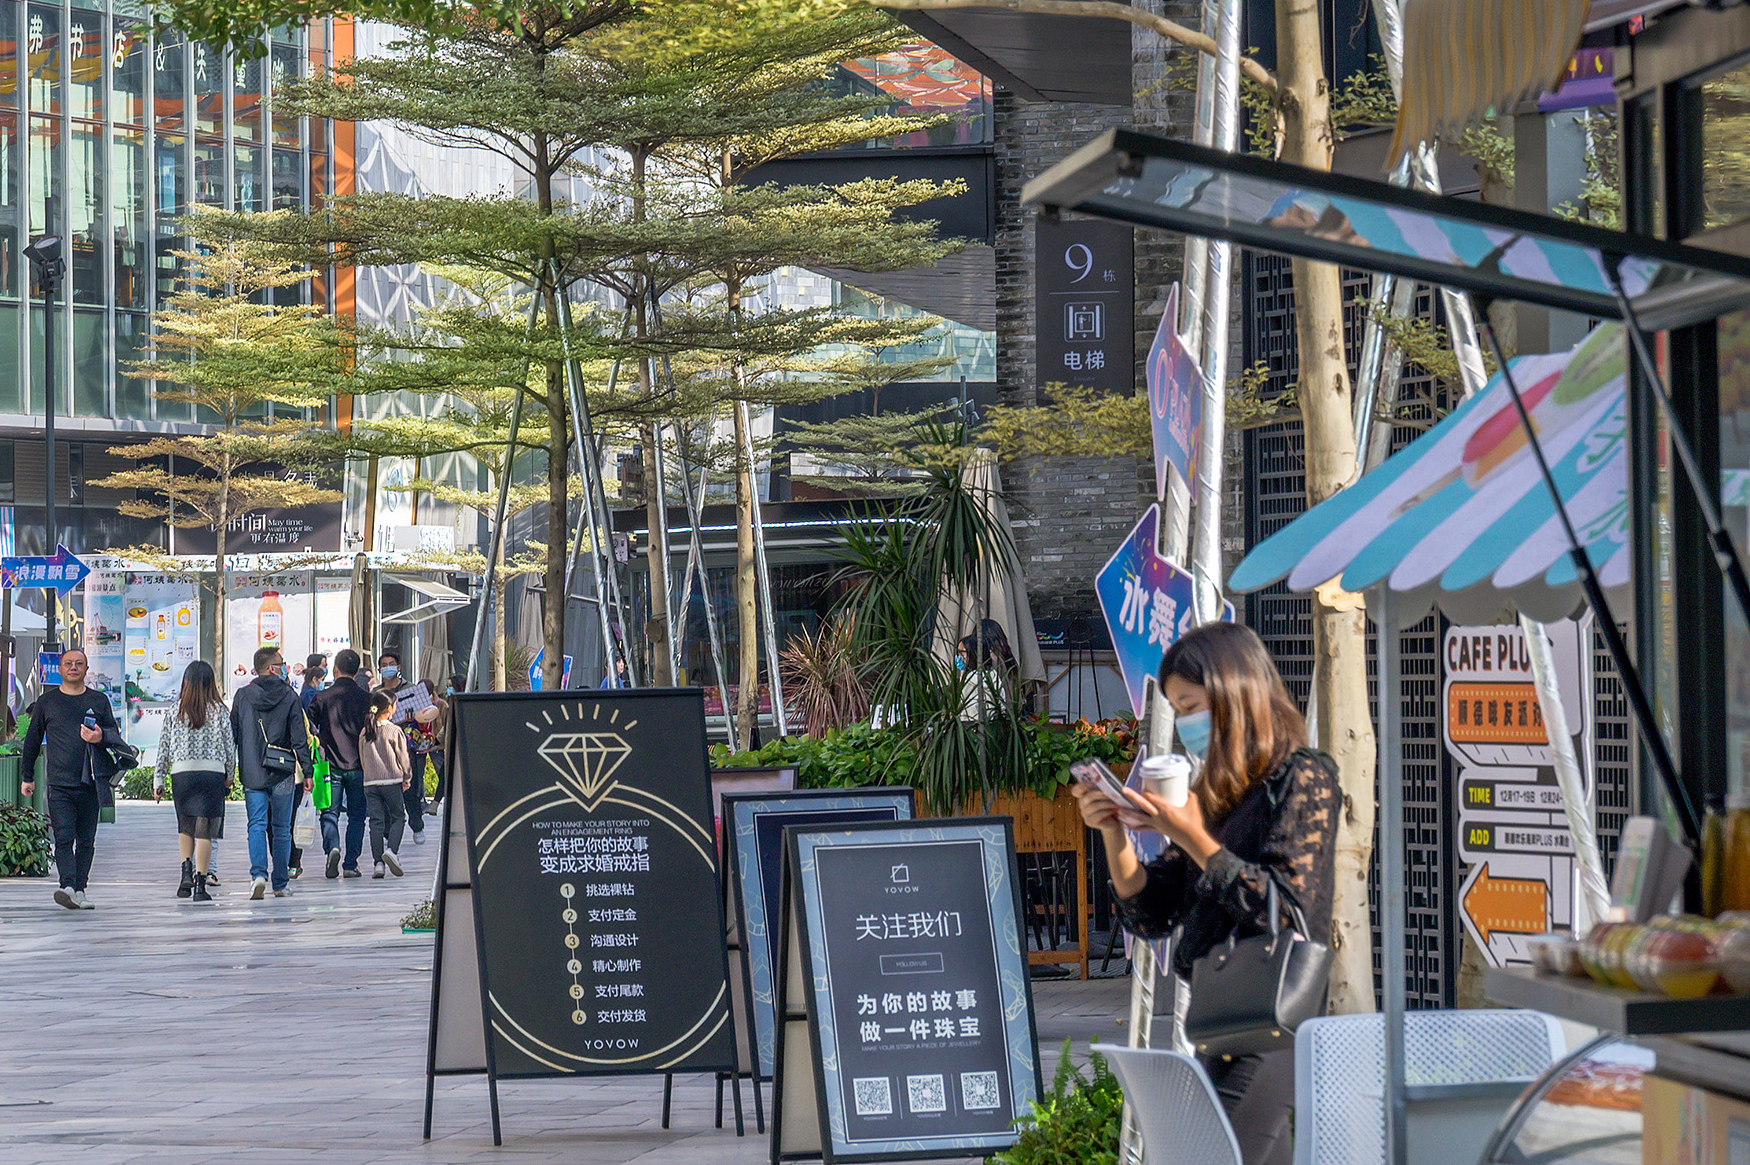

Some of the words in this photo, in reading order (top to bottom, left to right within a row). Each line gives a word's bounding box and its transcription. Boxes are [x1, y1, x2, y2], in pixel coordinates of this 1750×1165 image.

[1064, 349, 1105, 371] 电梯
[268, 519, 284, 527] May
[14, 564, 81, 581] 浪漫飘雪
[1448, 635, 1492, 673] CAFE
[1498, 634, 1540, 674] PLU
[1468, 787, 1491, 804] TIME
[537, 836, 649, 854] 怎样把你的故事
[1469, 829, 1490, 845] ADD
[540, 853, 650, 874] 变成求婚戒指
[586, 883, 635, 897] 挑选裸钻
[884, 885, 919, 894] YOVOW
[588, 908, 637, 922] 支付定金
[855, 910, 962, 941] 关注我们
[590, 934, 639, 947] 沟通设计
[592, 959, 642, 973] 精心制作
[595, 985, 644, 998] 支付尾款
[857, 989, 977, 1016] 为你的故事
[597, 1010, 647, 1023] 交付发货
[860, 1016, 981, 1043] 做一件珠宝
[584, 1039, 639, 1050] YOVOW
